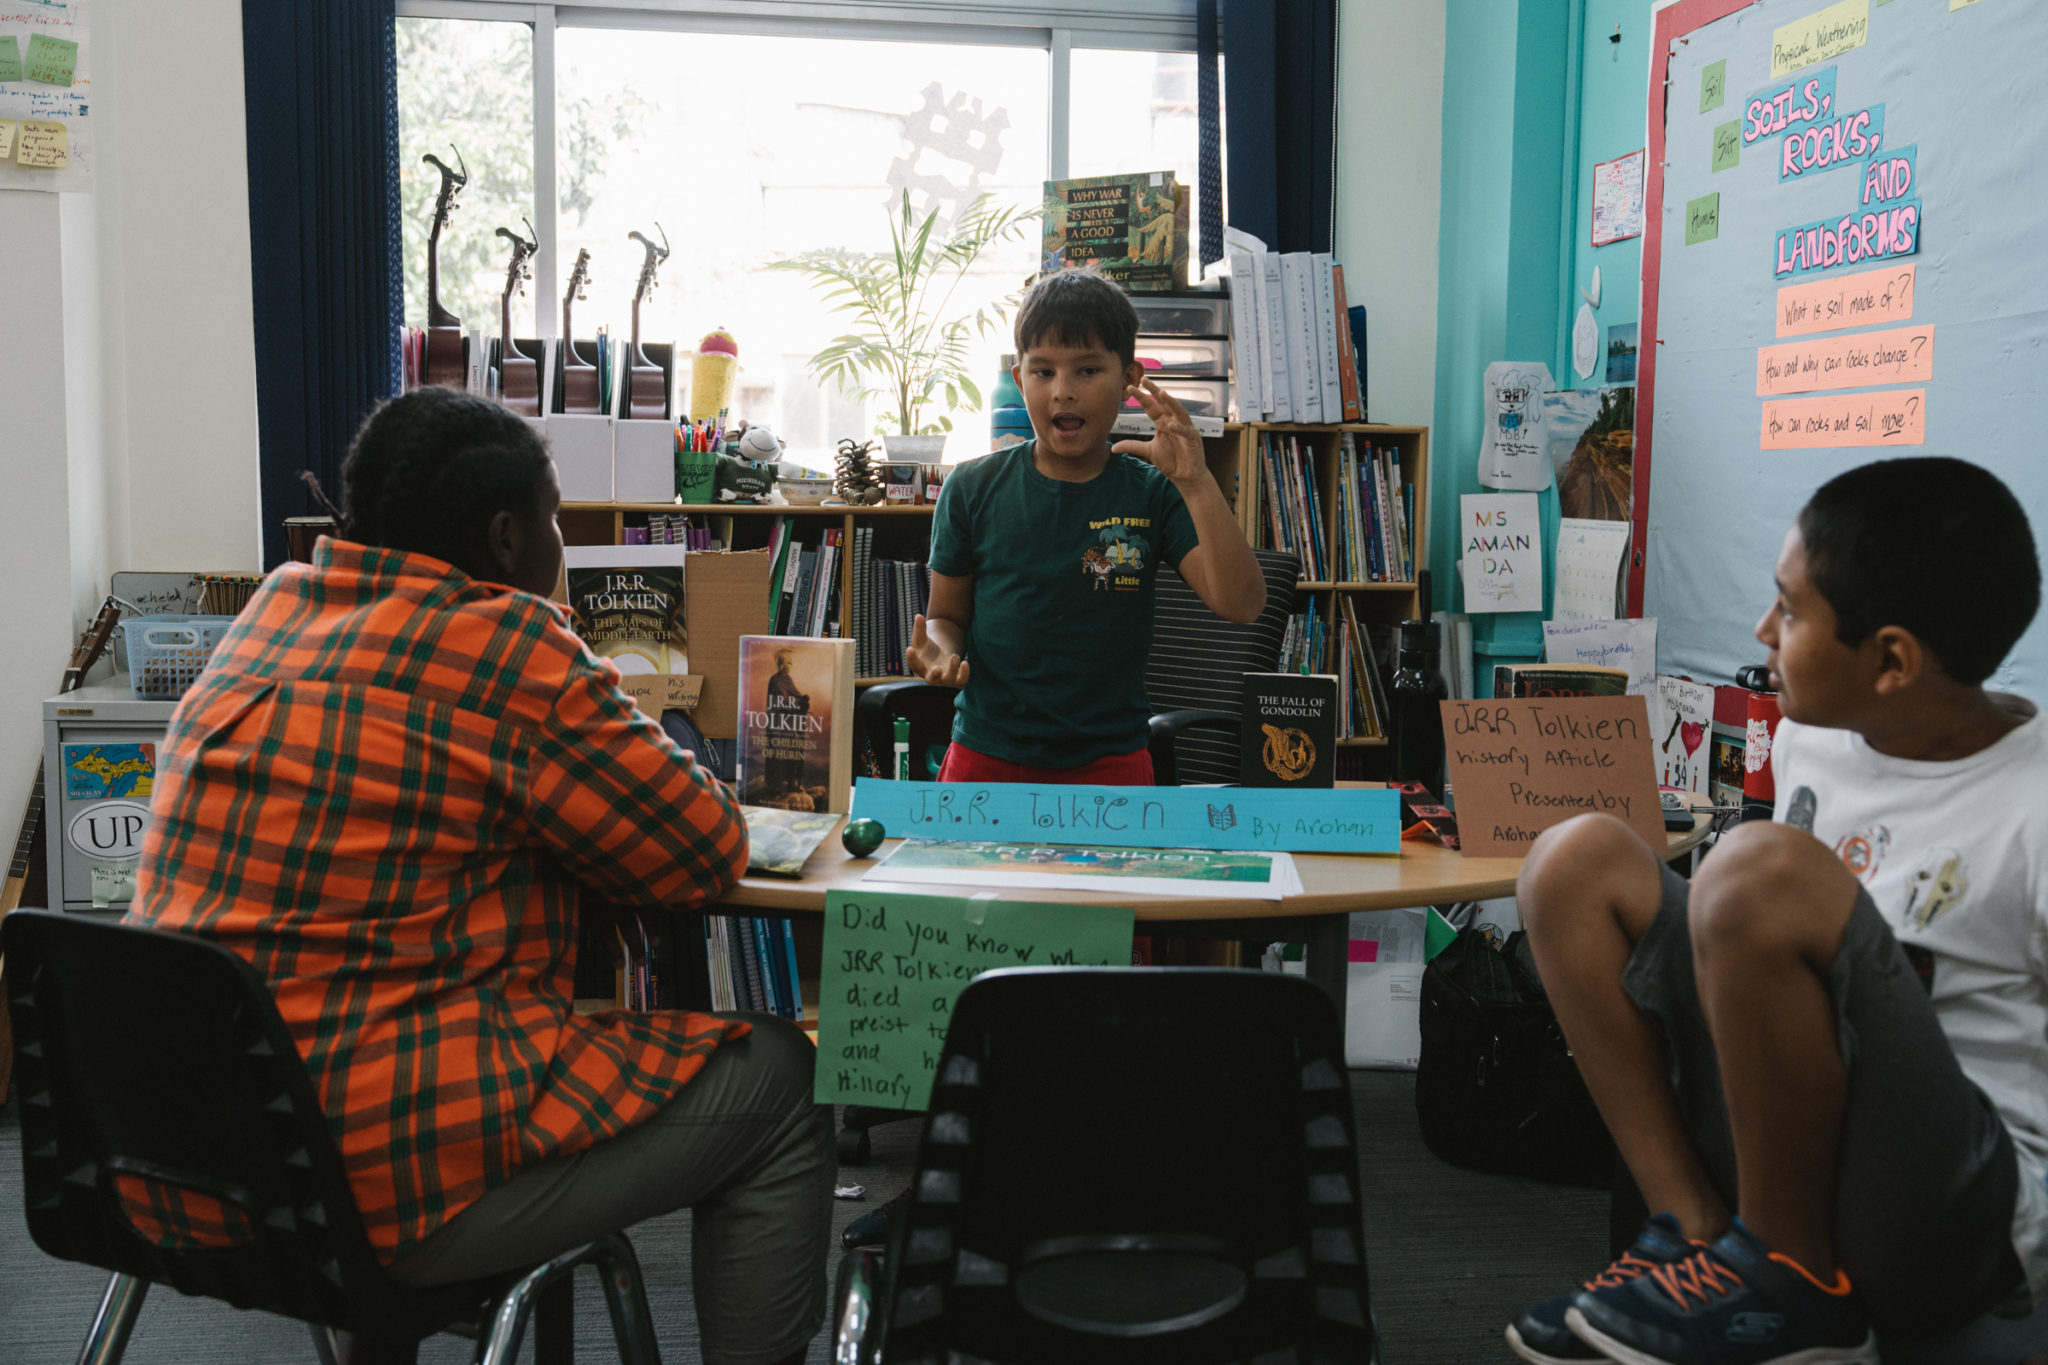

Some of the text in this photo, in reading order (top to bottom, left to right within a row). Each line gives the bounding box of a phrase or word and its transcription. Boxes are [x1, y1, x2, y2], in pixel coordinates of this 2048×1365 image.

[1774, 17, 1866, 69] Physical Weathering
[1705, 74, 1722, 104] Soil
[1743, 78, 1831, 143] SOILS,
[1782, 109, 1881, 179] ROCKS,
[1862, 157, 1912, 205] AND
[1072, 188, 1122, 202] WHY WAR
[1071, 208, 1115, 221] IS NEVER
[1071, 226, 1115, 239] A GOOD
[1775, 204, 1917, 276] LANDFORMS
[1071, 247, 1095, 257] IDEA
[1101, 269, 1131, 281] lker
[1785, 301, 1807, 326] What
[1813, 299, 1821, 321] is
[1827, 292, 1844, 320] soil
[1850, 290, 1875, 315] made
[1765, 358, 1781, 390] How
[1784, 354, 1798, 378] and
[1802, 353, 1819, 382] why
[1824, 356, 1841, 372] can
[1846, 349, 1869, 368] rocks
[1769, 409, 1783, 440] How
[1788, 419, 1801, 433] can
[1805, 412, 1830, 434] rocks
[1834, 412, 1850, 431] and
[1855, 405, 1874, 432] soil
[736, 477, 766, 487] MICHIGAN
[888, 486, 914, 497] WATER
[1123, 517, 1151, 528] FREE
[1475, 511, 1507, 527] MS
[1467, 534, 1530, 553] AMAN
[1482, 558, 1514, 576] DA
[605, 574, 650, 595] J.R.R.
[798, 569, 810, 607] NUMBER
[584, 593, 668, 610] TOLKIEN
[592, 617, 665, 629] THE MAPS OF
[627, 686, 651, 697] you
[768, 694, 801, 710] J.R.R.
[1257, 695, 1326, 707] THE FALL OF
[745, 711, 824, 733] TOLKIEN
[1260, 706, 1321, 717] GONDOLIN
[1454, 703, 1638, 741] J.R.R Tolkien
[751, 735, 817, 750] THE CHILDREN
[762, 749, 774, 758] OF
[1455, 747, 1616, 775] history Article
[1509, 782, 1632, 818] Presented by
[909, 788, 1374, 845] J.R.R. Tolkien By Arohan
[86, 815, 144, 849] UP
[1492, 825, 1543, 842] Aroha
[842, 903, 887, 931] Did
[905, 920, 949, 956] you
[966, 932, 1034, 962] know
[841, 949, 885, 974] JRR
[846, 982, 901, 1008] died
[849, 1015, 910, 1040] preist
[842, 1044, 881, 1064] and
[836, 1067, 911, 1110] Hillary
